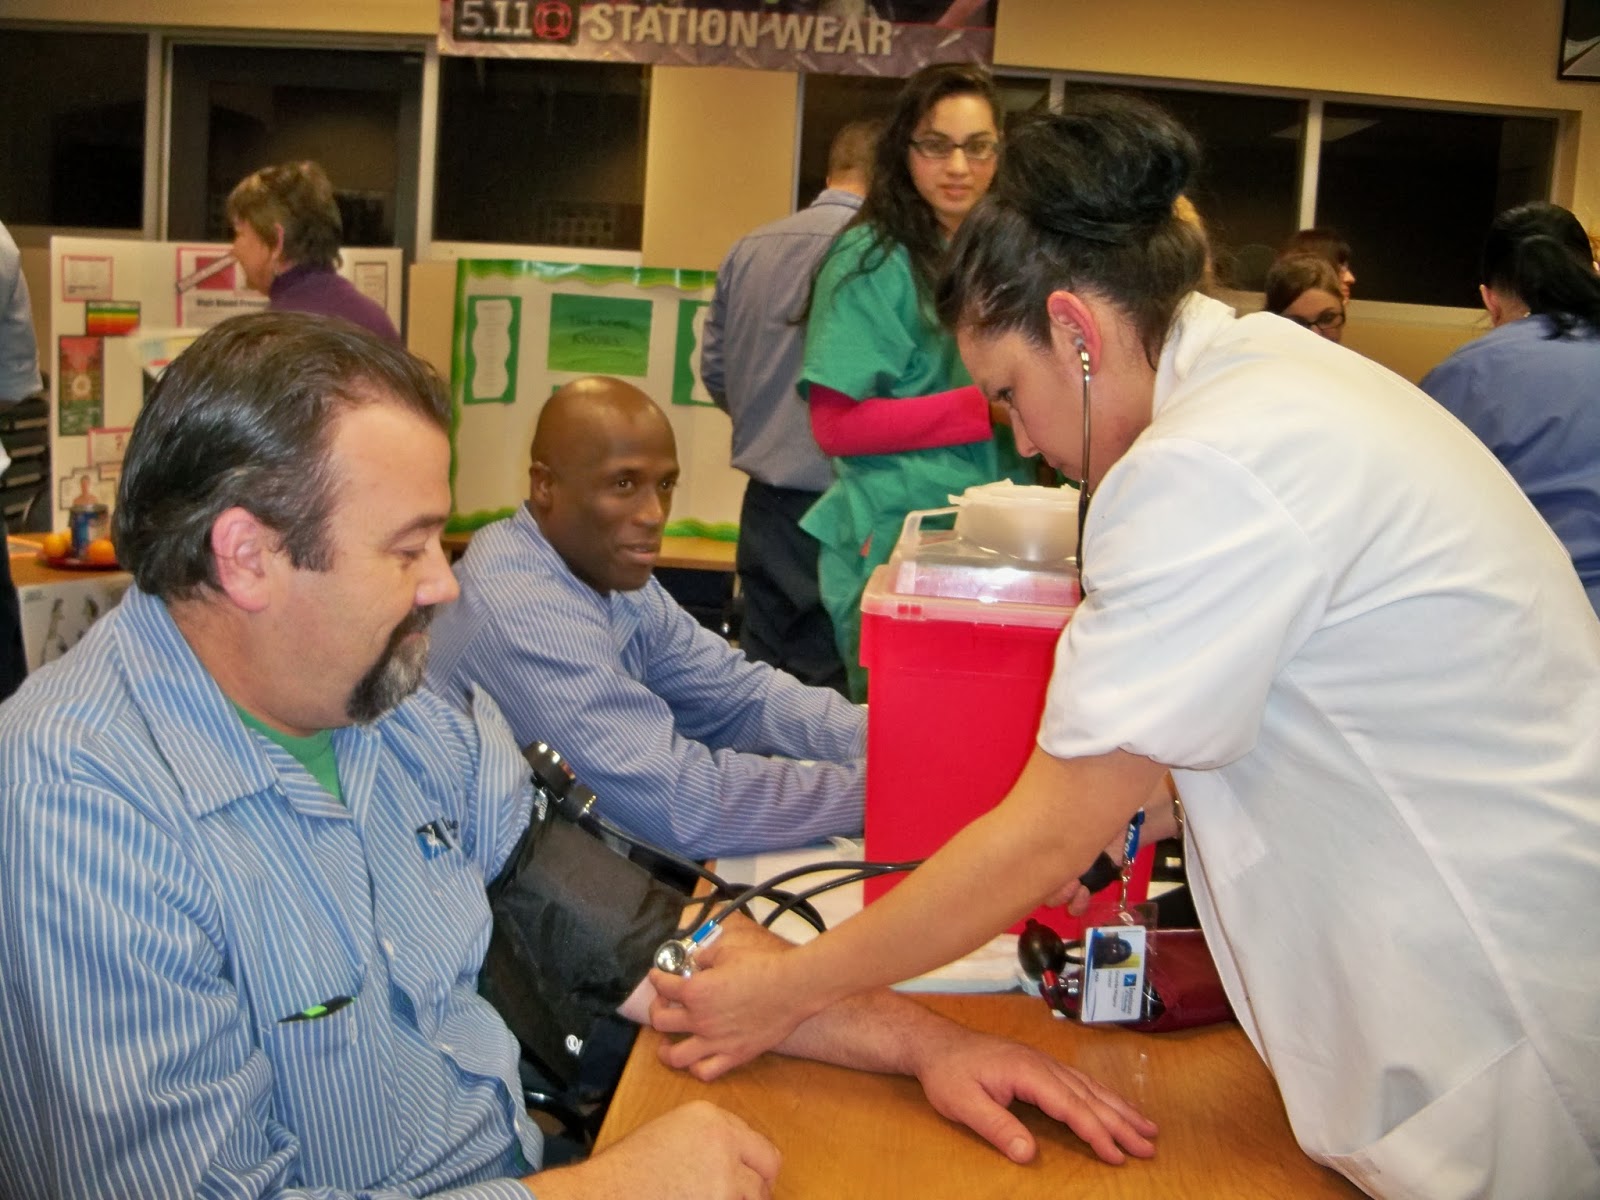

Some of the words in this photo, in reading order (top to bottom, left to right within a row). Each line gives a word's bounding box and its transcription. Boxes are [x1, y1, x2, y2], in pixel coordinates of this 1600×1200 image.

[460, 0, 533, 35] 5.11
[589, 3, 759, 48] STATION
[771, 12, 893, 56] WEAR
